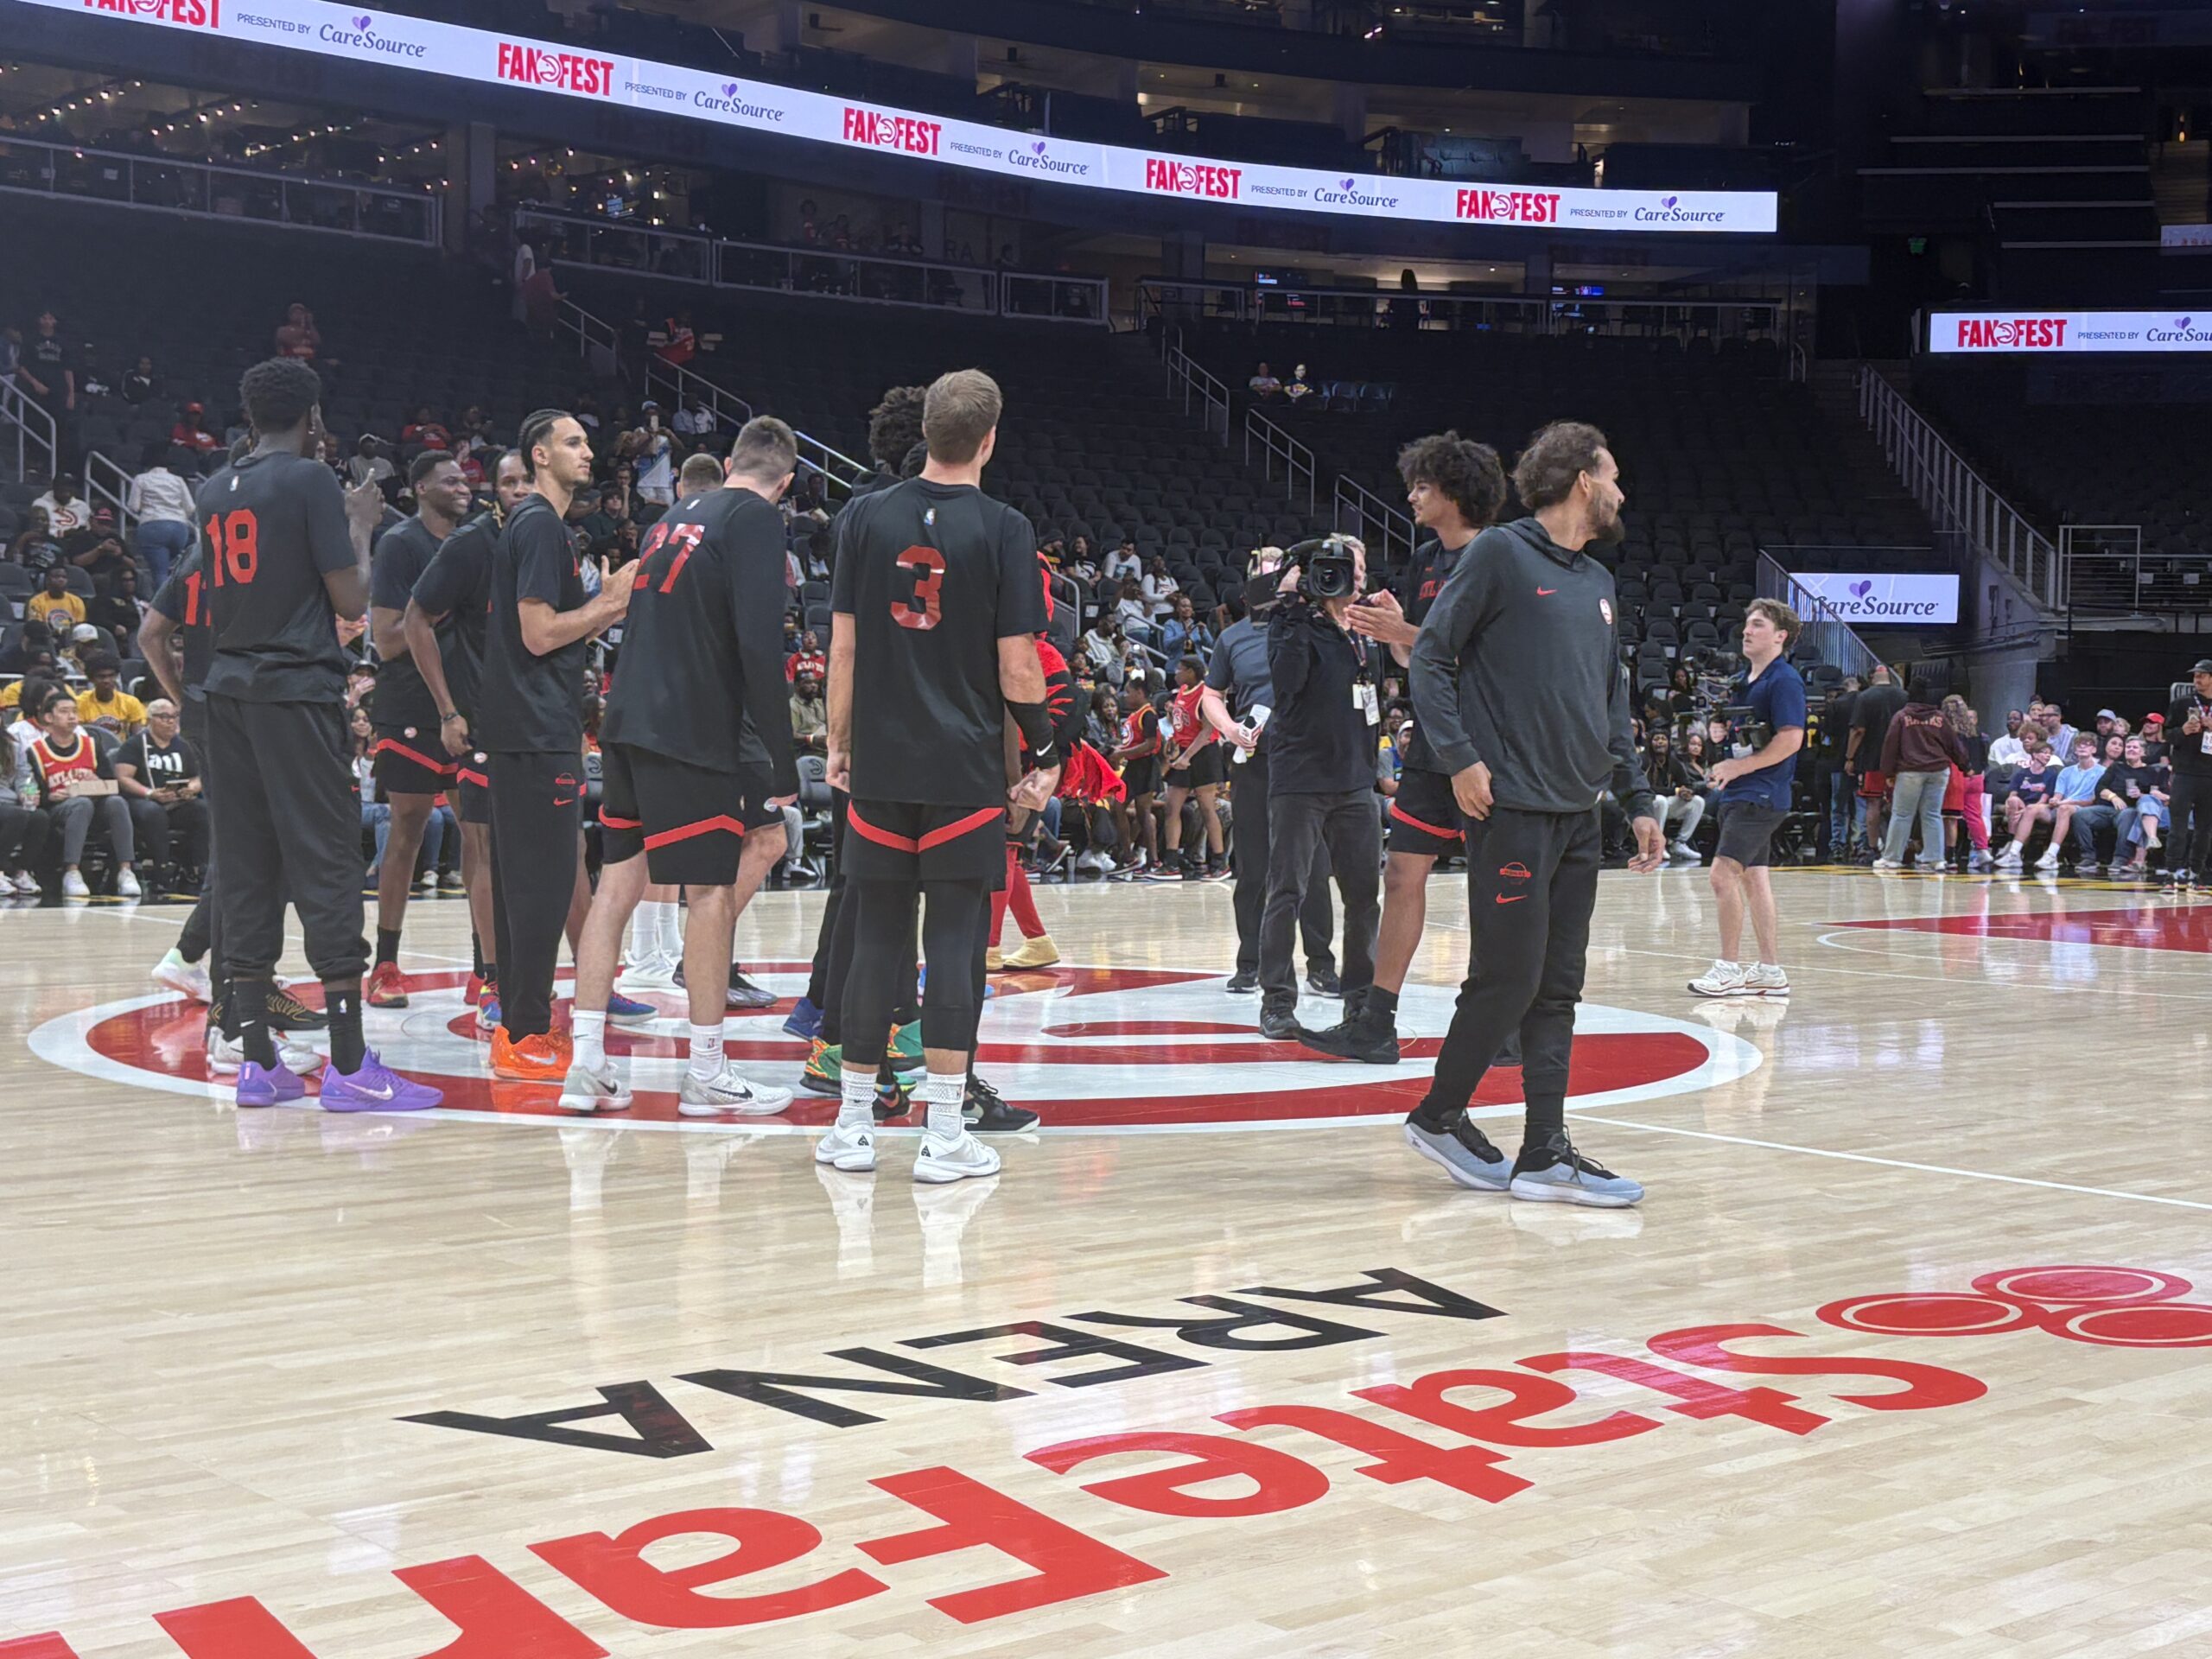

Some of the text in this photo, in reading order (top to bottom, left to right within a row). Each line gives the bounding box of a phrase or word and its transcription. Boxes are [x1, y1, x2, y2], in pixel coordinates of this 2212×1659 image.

[237, 13, 311, 35] PRESENTED BY
[320, 23, 426, 57] CareSource
[625, 82, 687, 101] PRESENTED BY
[694, 91, 784, 122] CareSource
[950, 142, 1002, 159] PRESENTED BY
[1008, 149, 1089, 175] CareSource
[1251, 184, 1308, 198] PRESENTED BY
[1314, 188, 1398, 207] CareSource
[1570, 207, 1616, 218] PRESENTED
[1635, 207, 1726, 222] CareSource
[206, 508, 257, 588] 18
[632, 522, 705, 594] 27
[184, 570, 211, 626] 1
[890, 545, 945, 631] 3
[148, 752, 183, 773] atl
[395, 1268, 1509, 1459] ARENA
